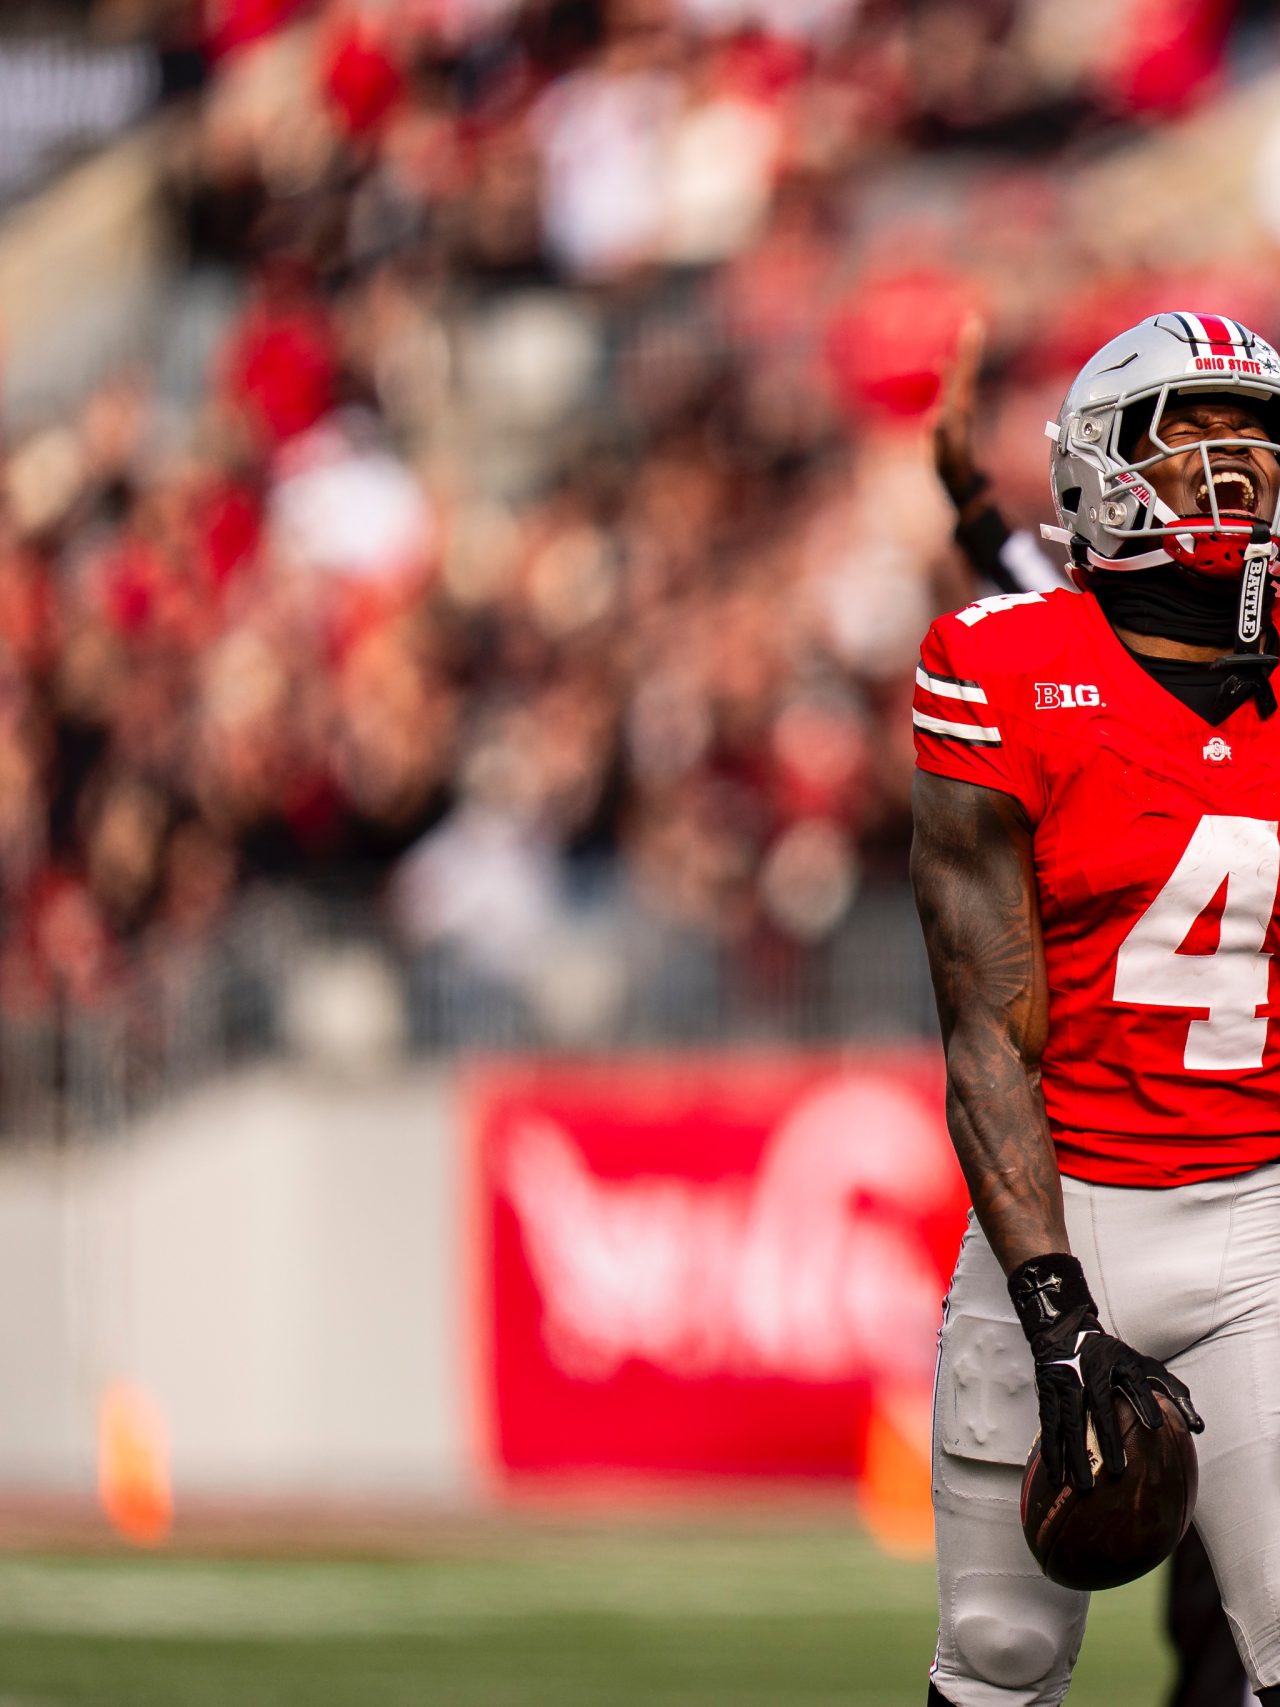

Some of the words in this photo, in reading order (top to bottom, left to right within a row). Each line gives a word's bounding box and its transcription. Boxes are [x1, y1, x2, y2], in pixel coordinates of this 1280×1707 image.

[1195, 358, 1225, 371] OHIO
[1228, 358, 1262, 375] STATE
[1242, 561, 1263, 634] BATTLE
[1112, 814, 1280, 1070] 4
